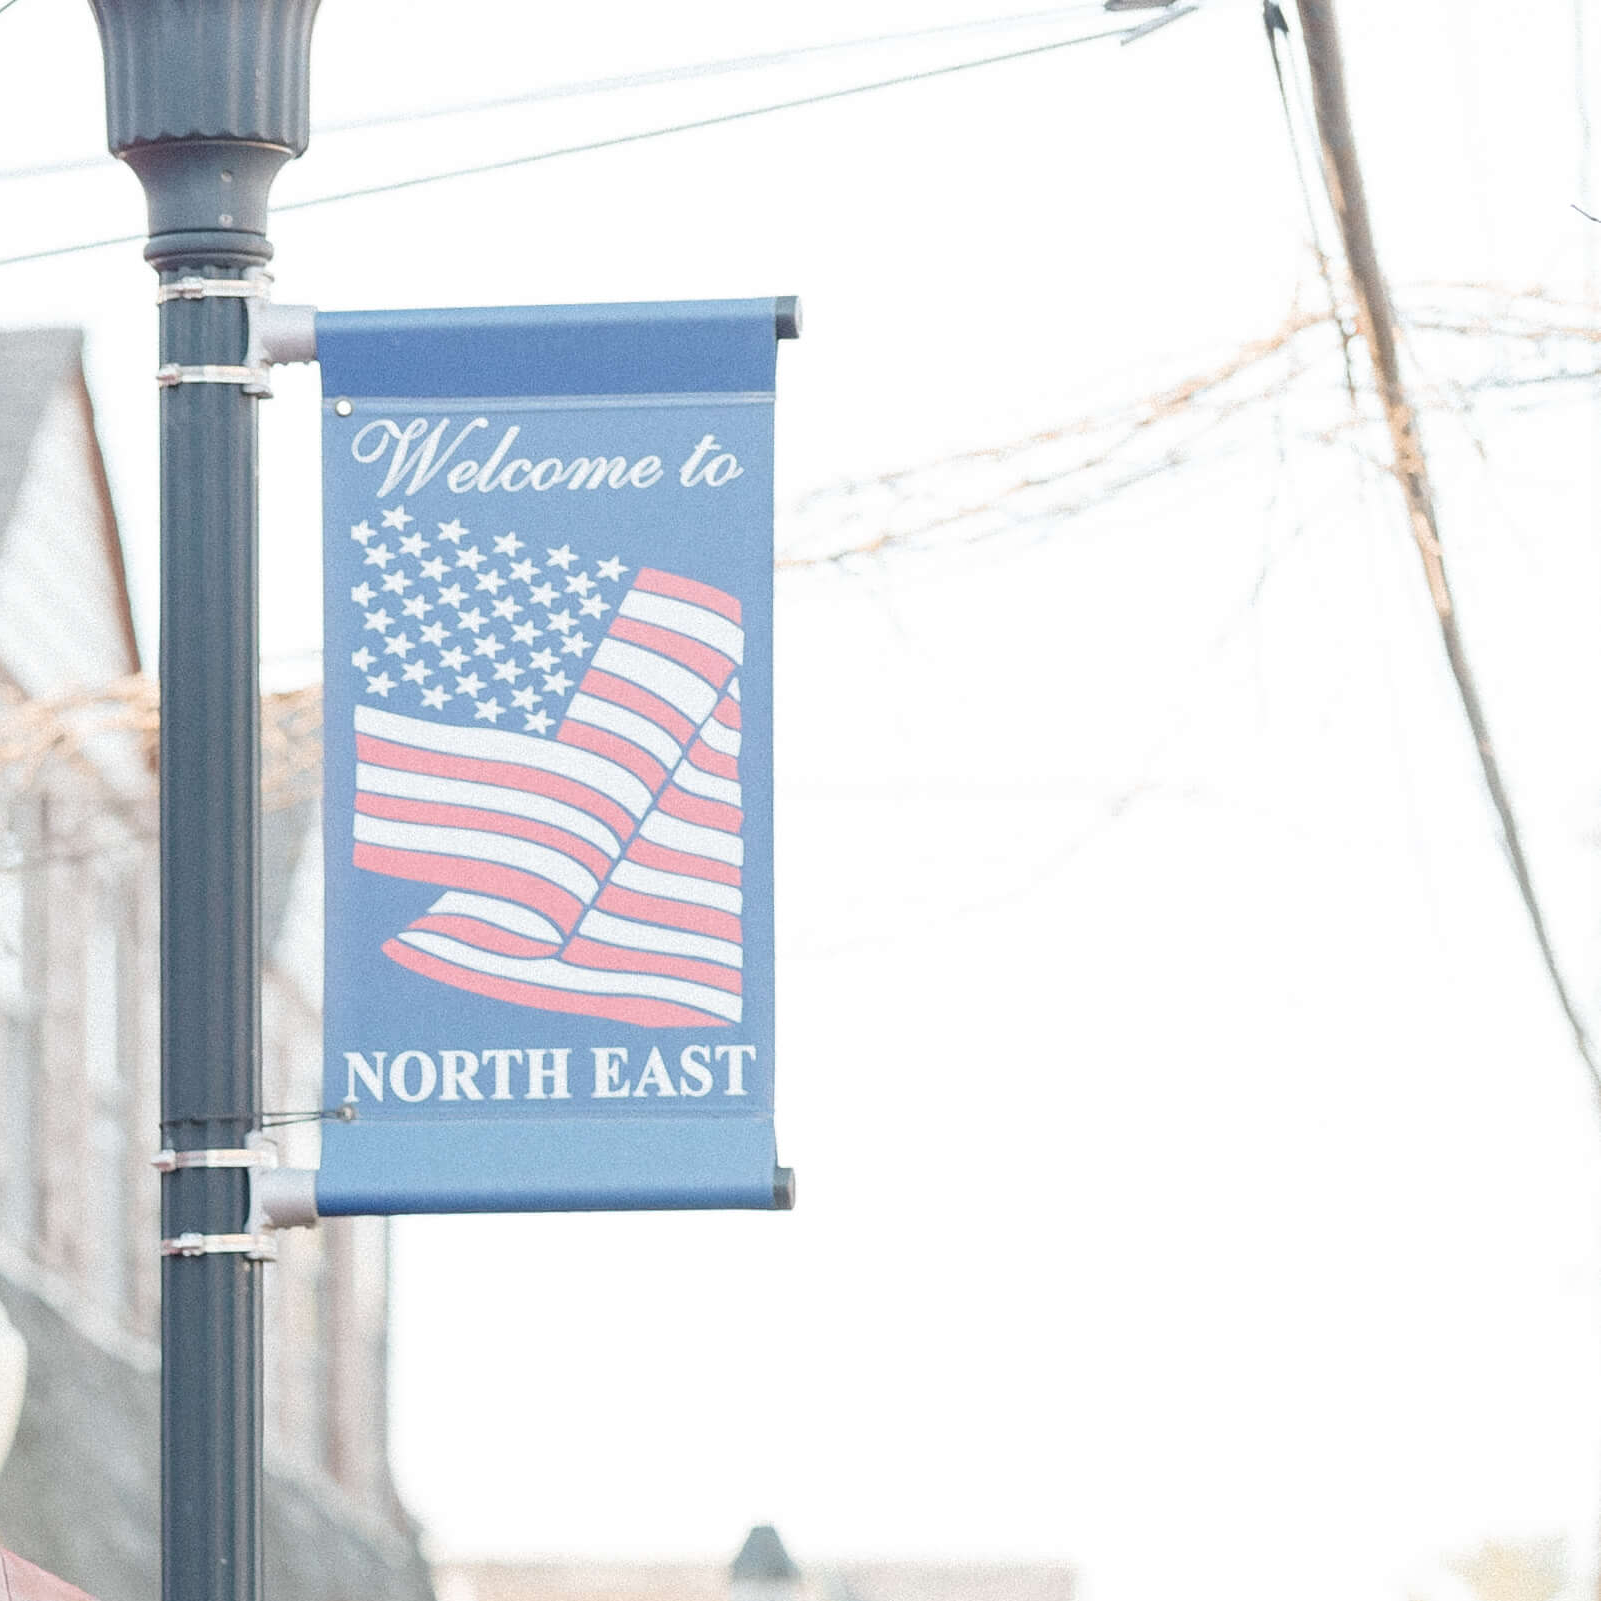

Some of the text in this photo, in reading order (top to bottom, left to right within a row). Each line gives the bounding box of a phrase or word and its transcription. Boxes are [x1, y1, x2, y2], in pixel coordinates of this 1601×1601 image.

[351, 417, 744, 498] Welcome to
[342, 1044, 757, 1102] NORTH EAST
